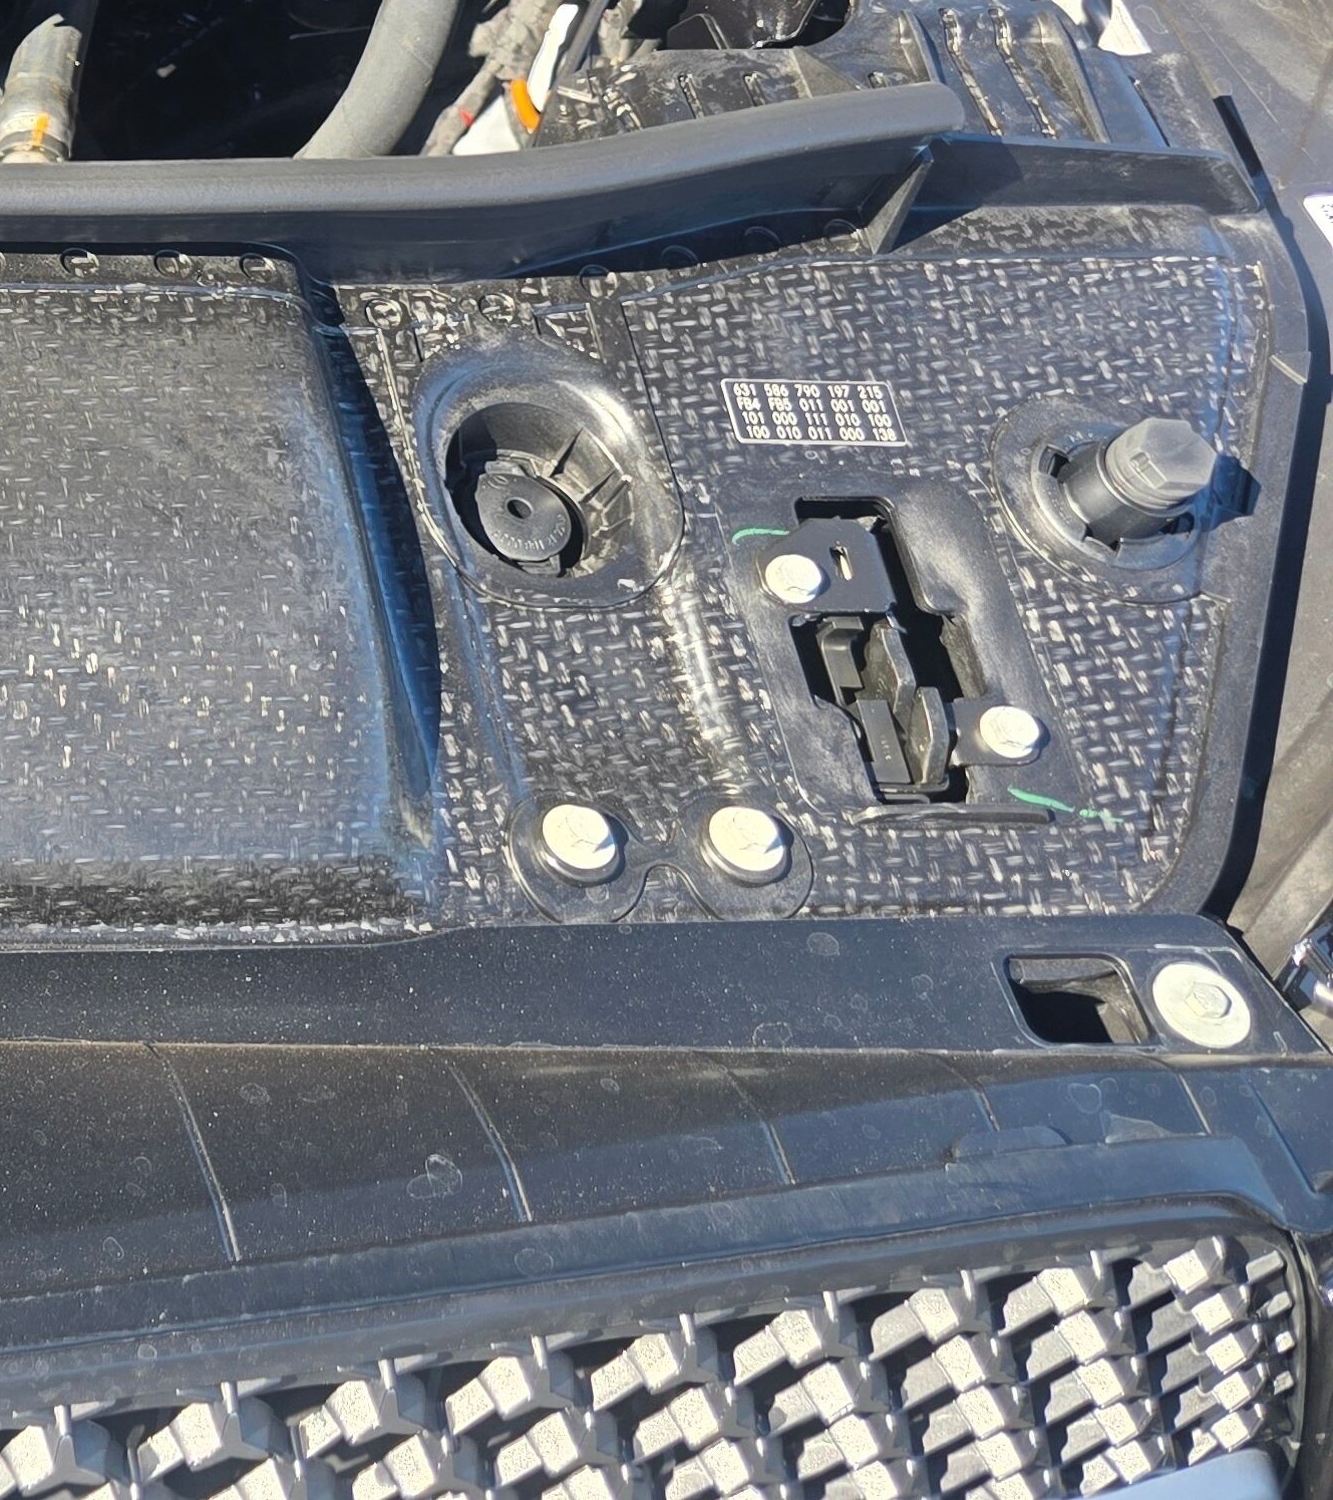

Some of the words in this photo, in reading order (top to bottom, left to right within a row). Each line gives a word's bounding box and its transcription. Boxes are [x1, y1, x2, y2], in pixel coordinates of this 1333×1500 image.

[733, 383, 756, 396] 631
[764, 383, 789, 396] 586
[794, 384, 820, 398] 790
[828, 385, 849, 398] 197
[857, 386, 883, 399] 215
[736, 396, 761, 410] FB4
[768, 397, 792, 411] FB5
[799, 398, 823, 411] 011
[830, 399, 855, 412] 001
[862, 400, 886, 413] 001
[742, 411, 764, 424] 101
[772, 411, 797, 425] 000
[805, 413, 827, 426] 111
[835, 413, 861, 426] 010
[868, 413, 891, 427] 100
[746, 425, 770, 438] 100
[776, 426, 802, 440] 010
[808, 426, 832, 440] 011
[839, 427, 865, 440] 000
[873, 428, 897, 442] 138
